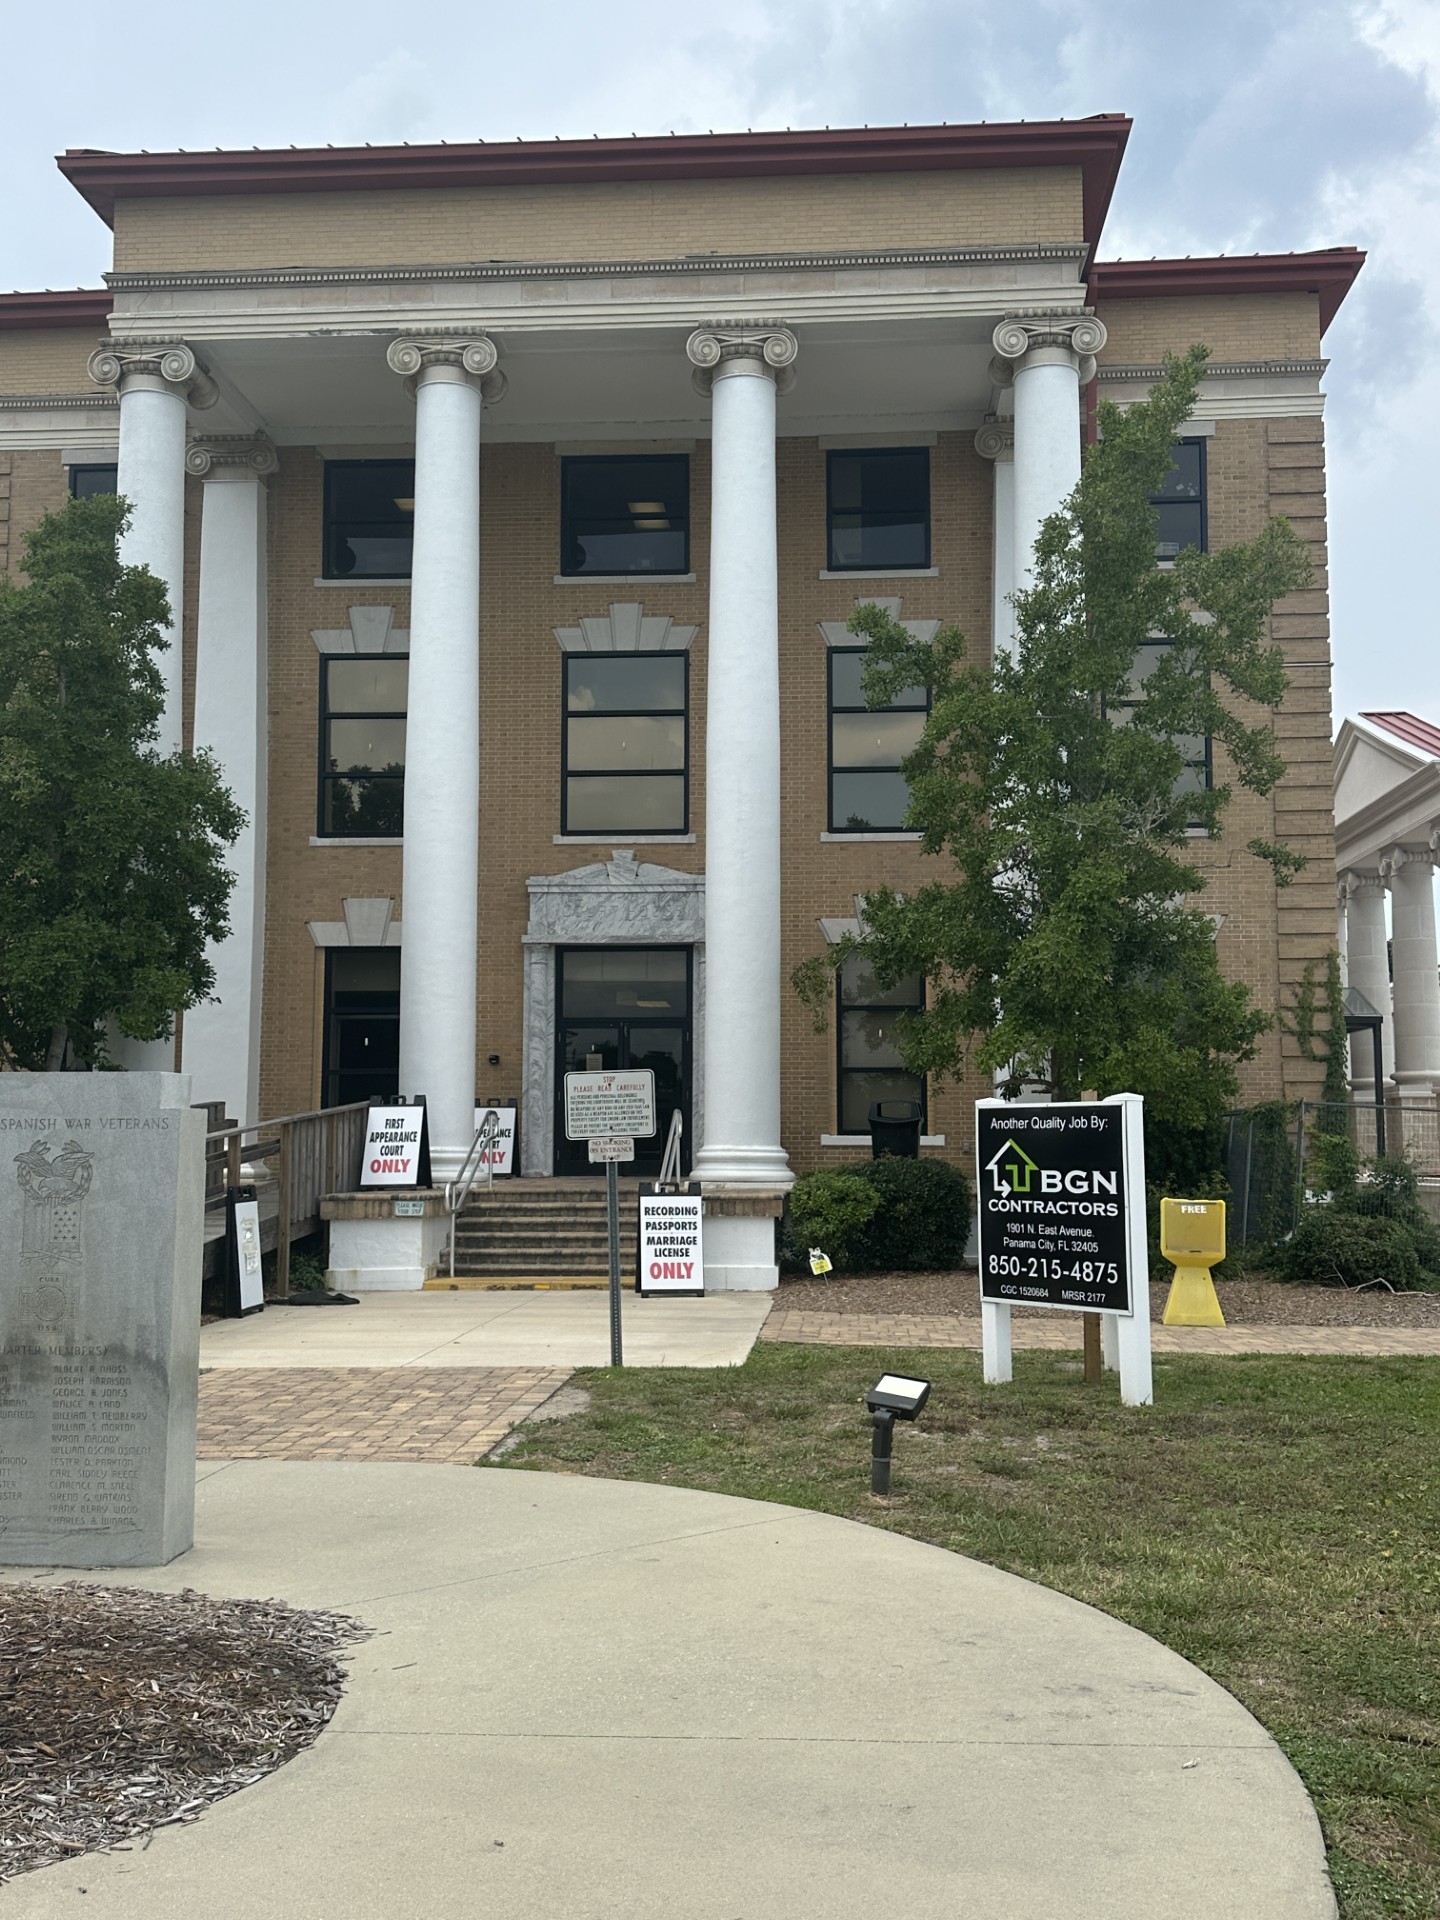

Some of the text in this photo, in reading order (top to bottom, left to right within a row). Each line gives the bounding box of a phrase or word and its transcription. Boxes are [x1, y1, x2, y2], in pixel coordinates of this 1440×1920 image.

[573, 1085, 593, 1093] PLEASE
[616, 1083, 646, 1091] CAREFULLY
[0, 1117, 169, 1130] SPANISH WAR VETERANS
[385, 1118, 405, 1129] FIRST
[990, 1115, 1108, 1131] Another Quality Job By:
[369, 1131, 418, 1143] APPEARANCE
[380, 1145, 404, 1156] COURT
[370, 1159, 411, 1173] ONLY
[1040, 1169, 1118, 1195] BGN
[644, 1206, 698, 1216] RECORDING
[988, 1199, 1119, 1217] CONTRACTORS
[1181, 1205, 1207, 1214] FREE
[645, 1221, 698, 1231] PASSPORTS
[1006, 1223, 1025, 1234] 1901
[1027, 1224, 1037, 1234] N.
[1038, 1225, 1058, 1236] East
[646, 1236, 698, 1246] MARRIAGE
[1003, 1237, 1036, 1249] Panama
[1058, 1241, 1070, 1251] FL
[1071, 1241, 1099, 1253] 32405
[654, 1248, 690, 1257] LICENSE
[649, 1262, 695, 1280] ONLY
[989, 1254, 1119, 1284] 850-215-4875
[1000, 1284, 1106, 1303] CGC 1520684 MRSR 2177
[54, 1377, 84, 1385] JOSEPH
[52, 1388, 85, 1397] GEORGE
[101, 1388, 128, 1397] JONES
[100, 1400, 121, 1409] LAND
[101, 1411, 148, 1420] NEWBERRY
[84, 1435, 120, 1443] MADDOX
[87, 1446, 116, 1455] OSCAR
[49, 1469, 72, 1477] CARL
